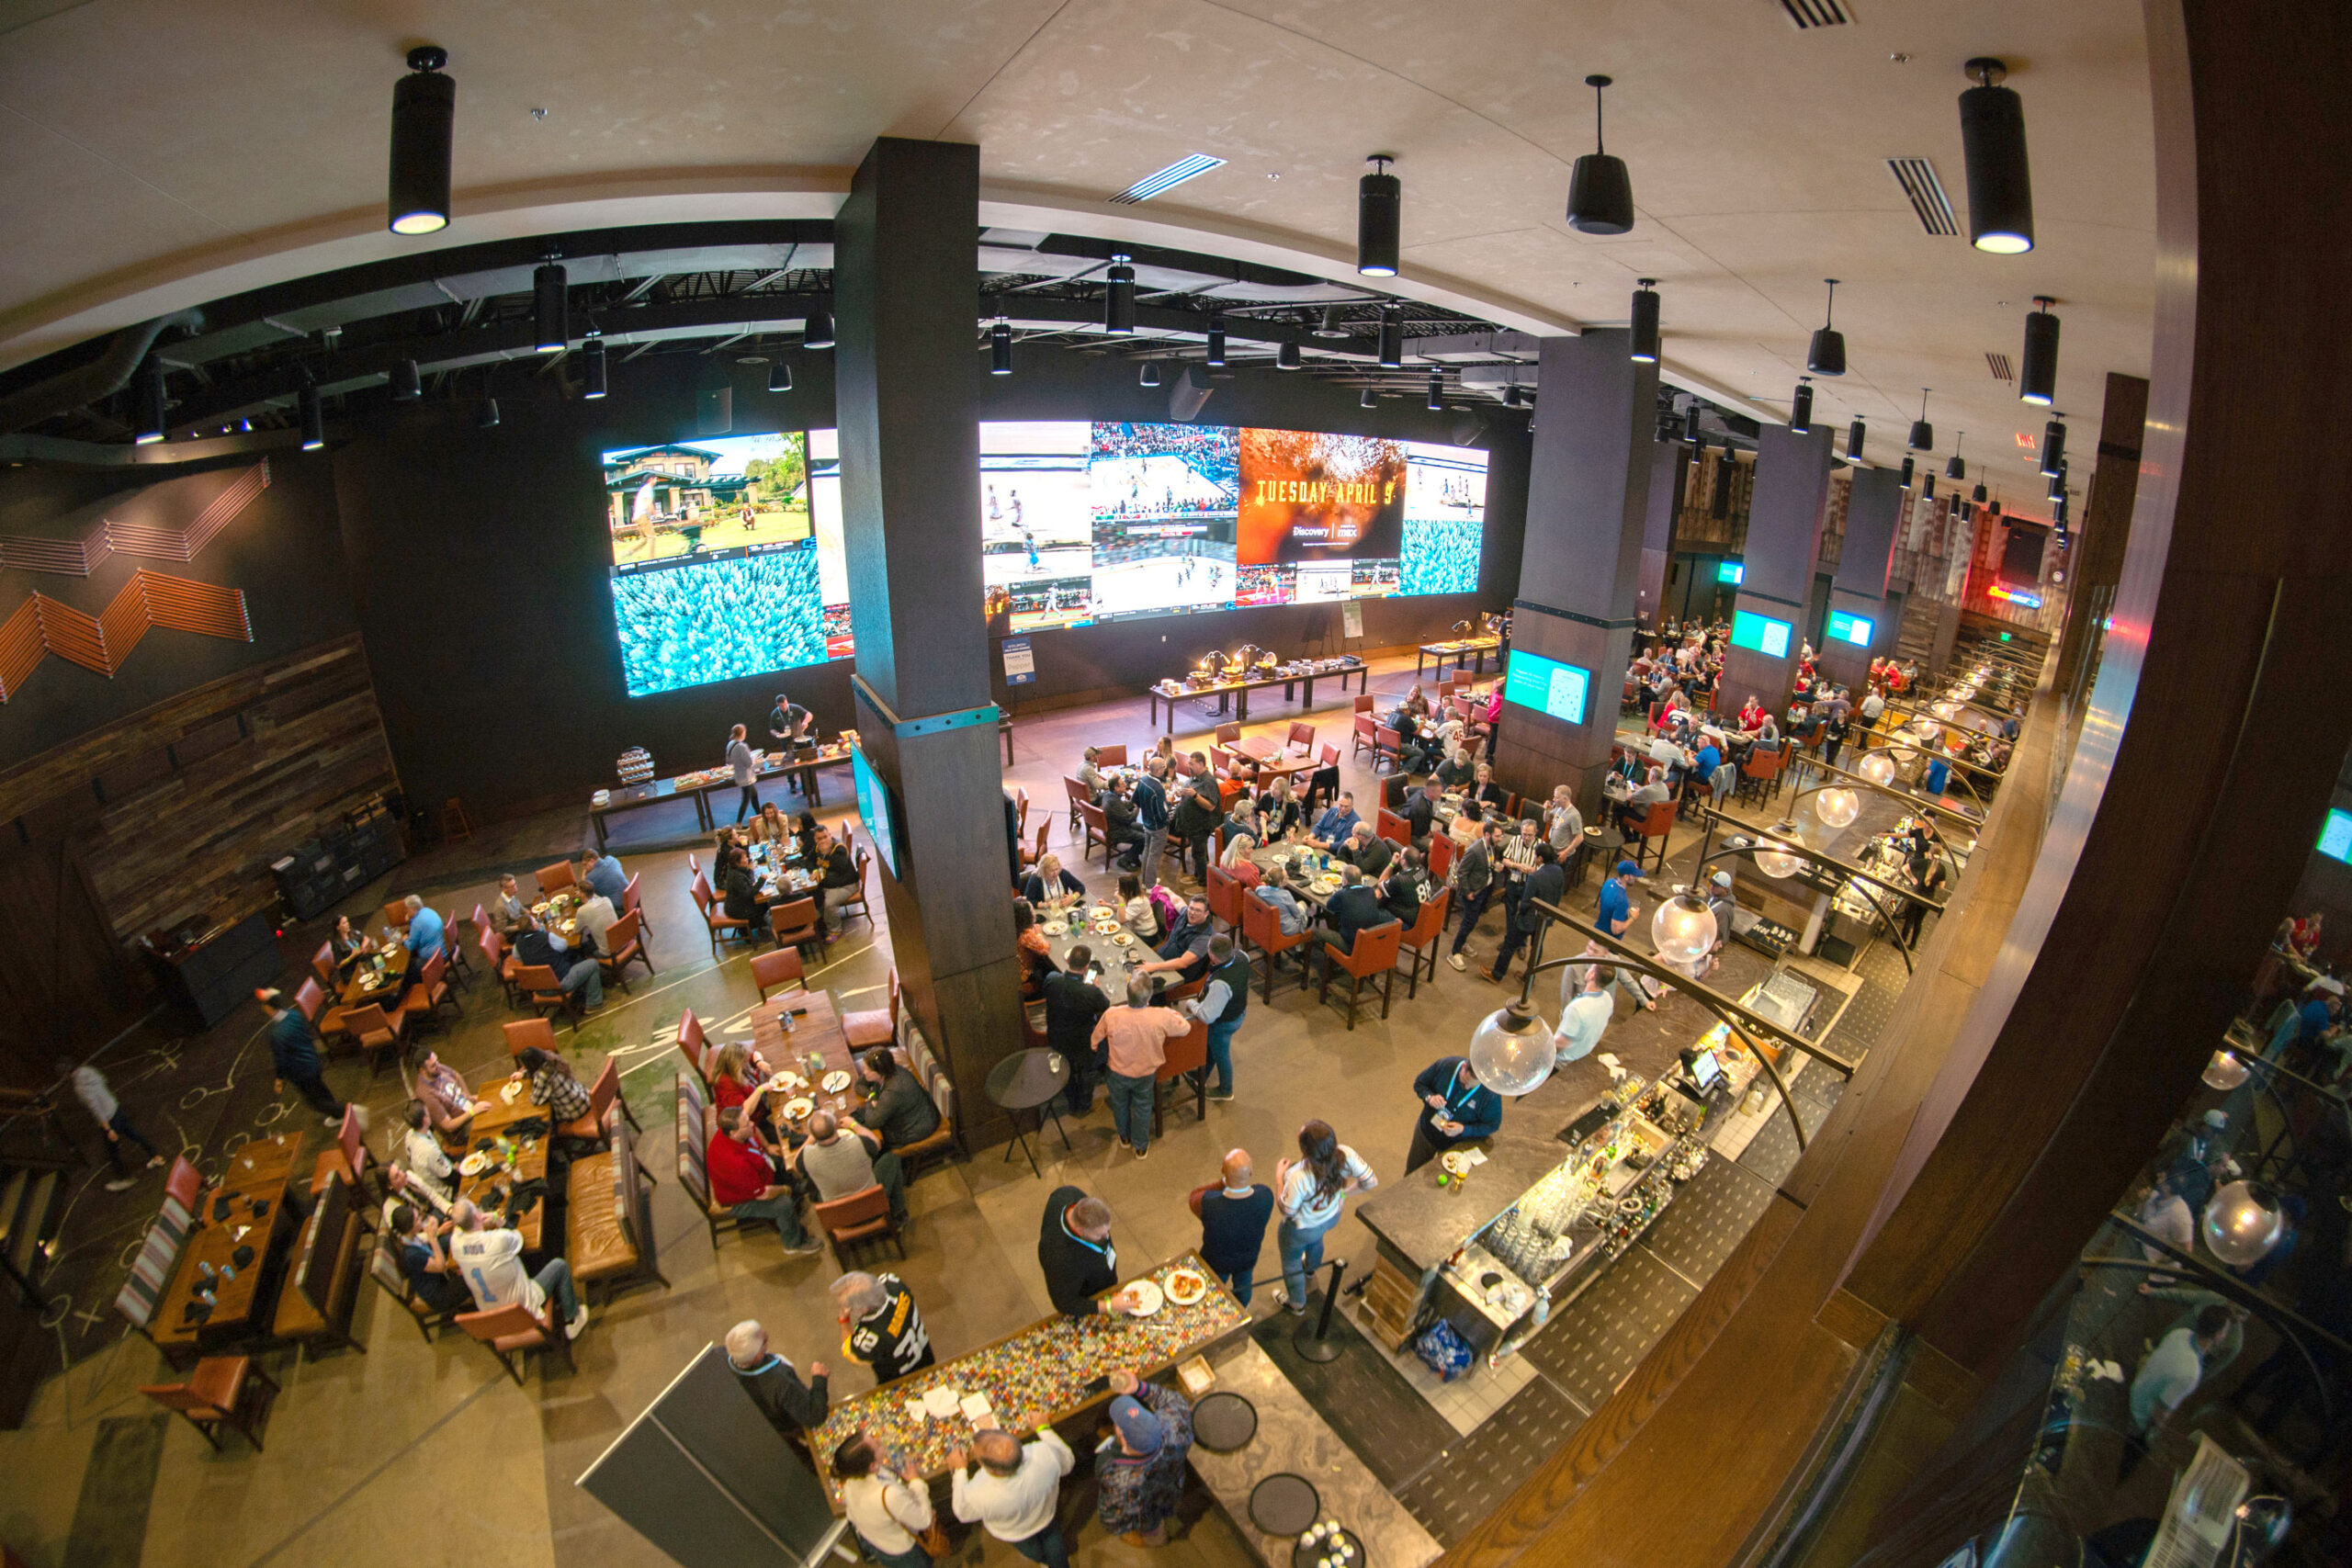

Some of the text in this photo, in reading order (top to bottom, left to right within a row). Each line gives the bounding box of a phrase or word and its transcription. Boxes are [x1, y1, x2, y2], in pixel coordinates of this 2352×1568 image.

[1257, 479, 1396, 506] TUESDAY APRIL 9
[1293, 525, 1329, 537] Discovery
[1416, 879, 1431, 904] 88
[471, 1268, 497, 1302] 1
[853, 1326, 879, 1353] 32
